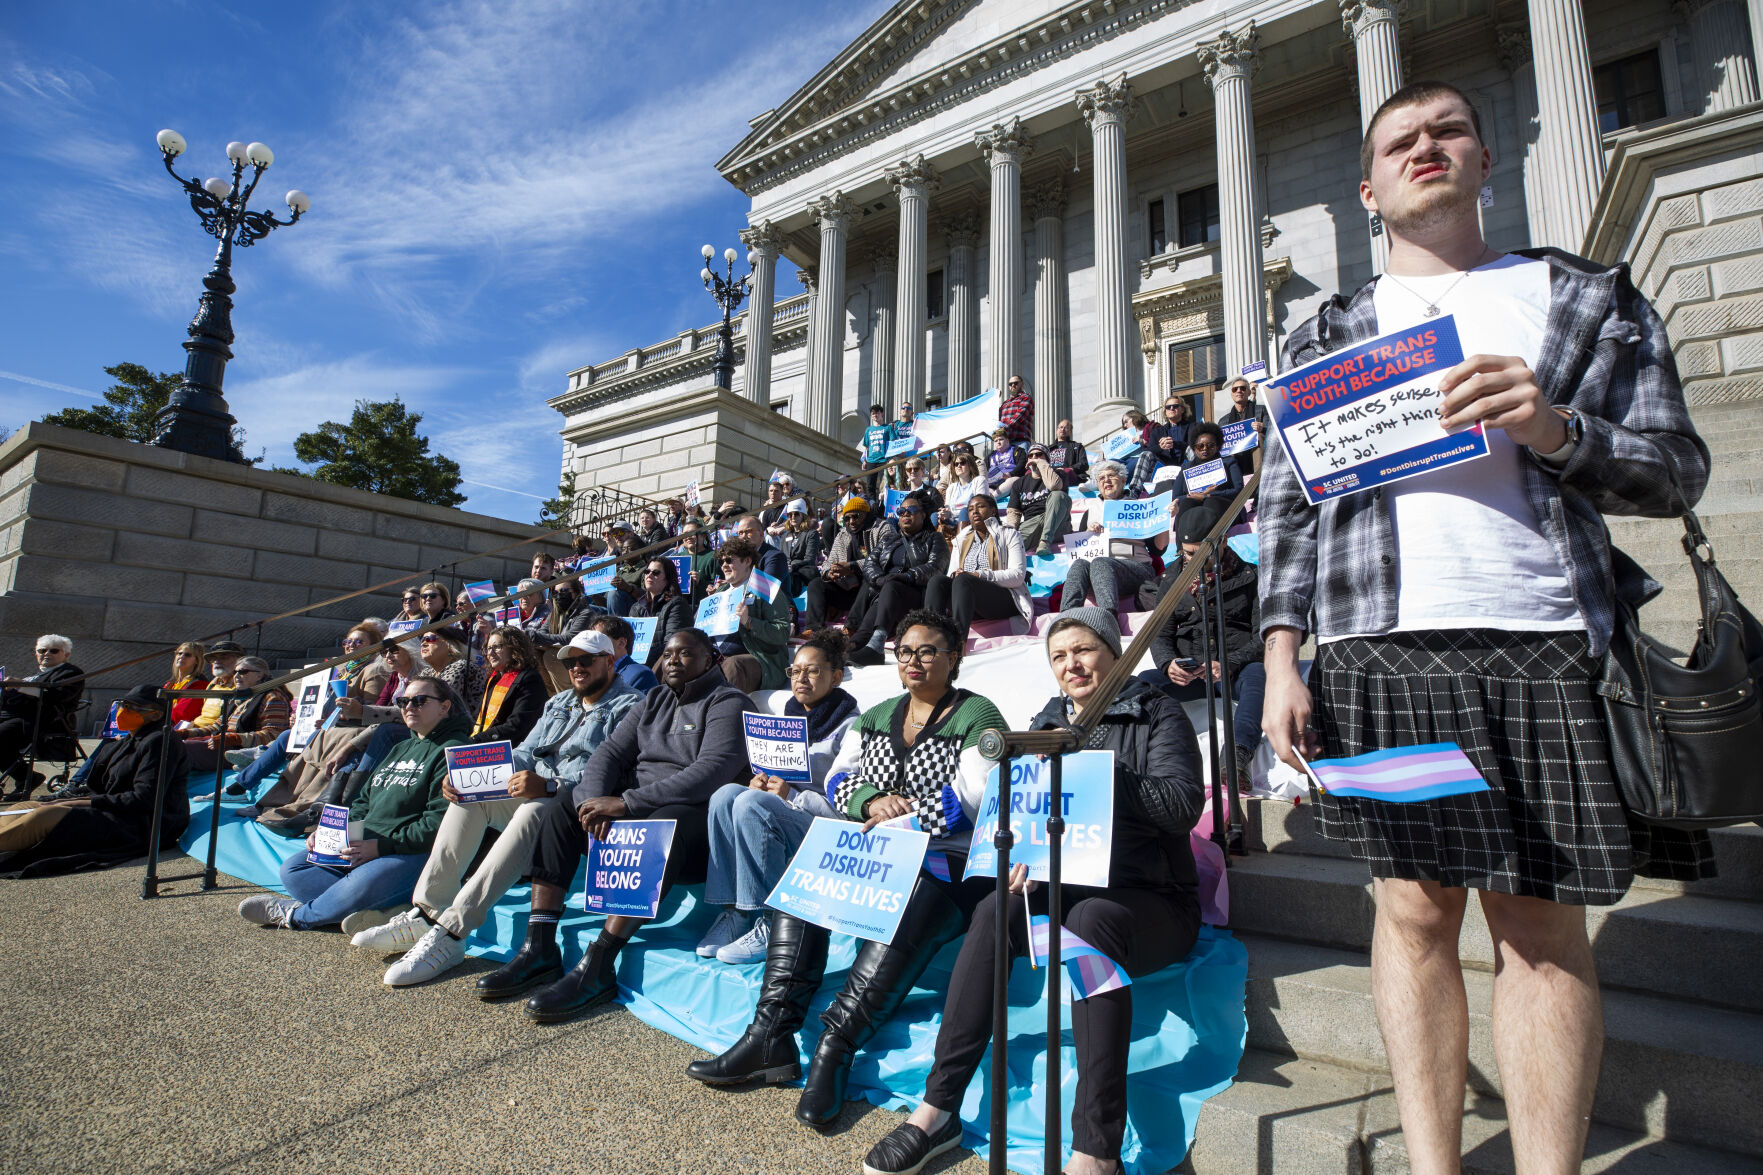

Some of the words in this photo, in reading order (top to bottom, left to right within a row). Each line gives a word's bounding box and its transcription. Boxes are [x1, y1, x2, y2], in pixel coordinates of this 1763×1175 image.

[1280, 388, 1287, 400] I
[1290, 354, 1364, 396] SUPPORT
[1369, 330, 1438, 364] TRANS
[1290, 382, 1348, 414] YOUTH
[1350, 348, 1436, 392] BECAUSE
[1298, 420, 1332, 444] It
[1337, 398, 1386, 426] makes
[1390, 386, 1441, 406] sense,
[1311, 442, 1336, 458] it's
[1338, 434, 1362, 448] the
[1366, 418, 1398, 438] right
[1330, 456, 1347, 468] to
[1353, 444, 1378, 460] do!
[1380, 444, 1475, 476] #DontDisruptTransLives
[1332, 473, 1358, 485] UNITED
[1124, 500, 1155, 511] DON'T
[1118, 508, 1159, 520] DISRUPT
[1144, 512, 1168, 528] LIVES
[1075, 539, 1088, 547] NO
[1084, 549, 1104, 558] 4624
[398, 622, 415, 630] TRANS
[749, 717, 775, 727] SUPPORT
[777, 721, 803, 729] TRANS
[748, 726, 766, 736] YOUTH
[768, 729, 801, 738] BECAUSE
[456, 750, 482, 758] SUPPORT
[484, 746, 505, 755] TRANS
[750, 740, 768, 752] THEY
[775, 743, 793, 753] ARE
[477, 754, 504, 763] BECAUSE
[460, 766, 503, 788] LOVE
[601, 828, 647, 844] RANS
[836, 830, 891, 855] DON'T
[599, 849, 643, 867] YOUTH
[819, 852, 893, 883] DISRUPT
[596, 871, 641, 890] BELONG
[790, 868, 850, 901] TRANS
[850, 883, 903, 914] LIVES
